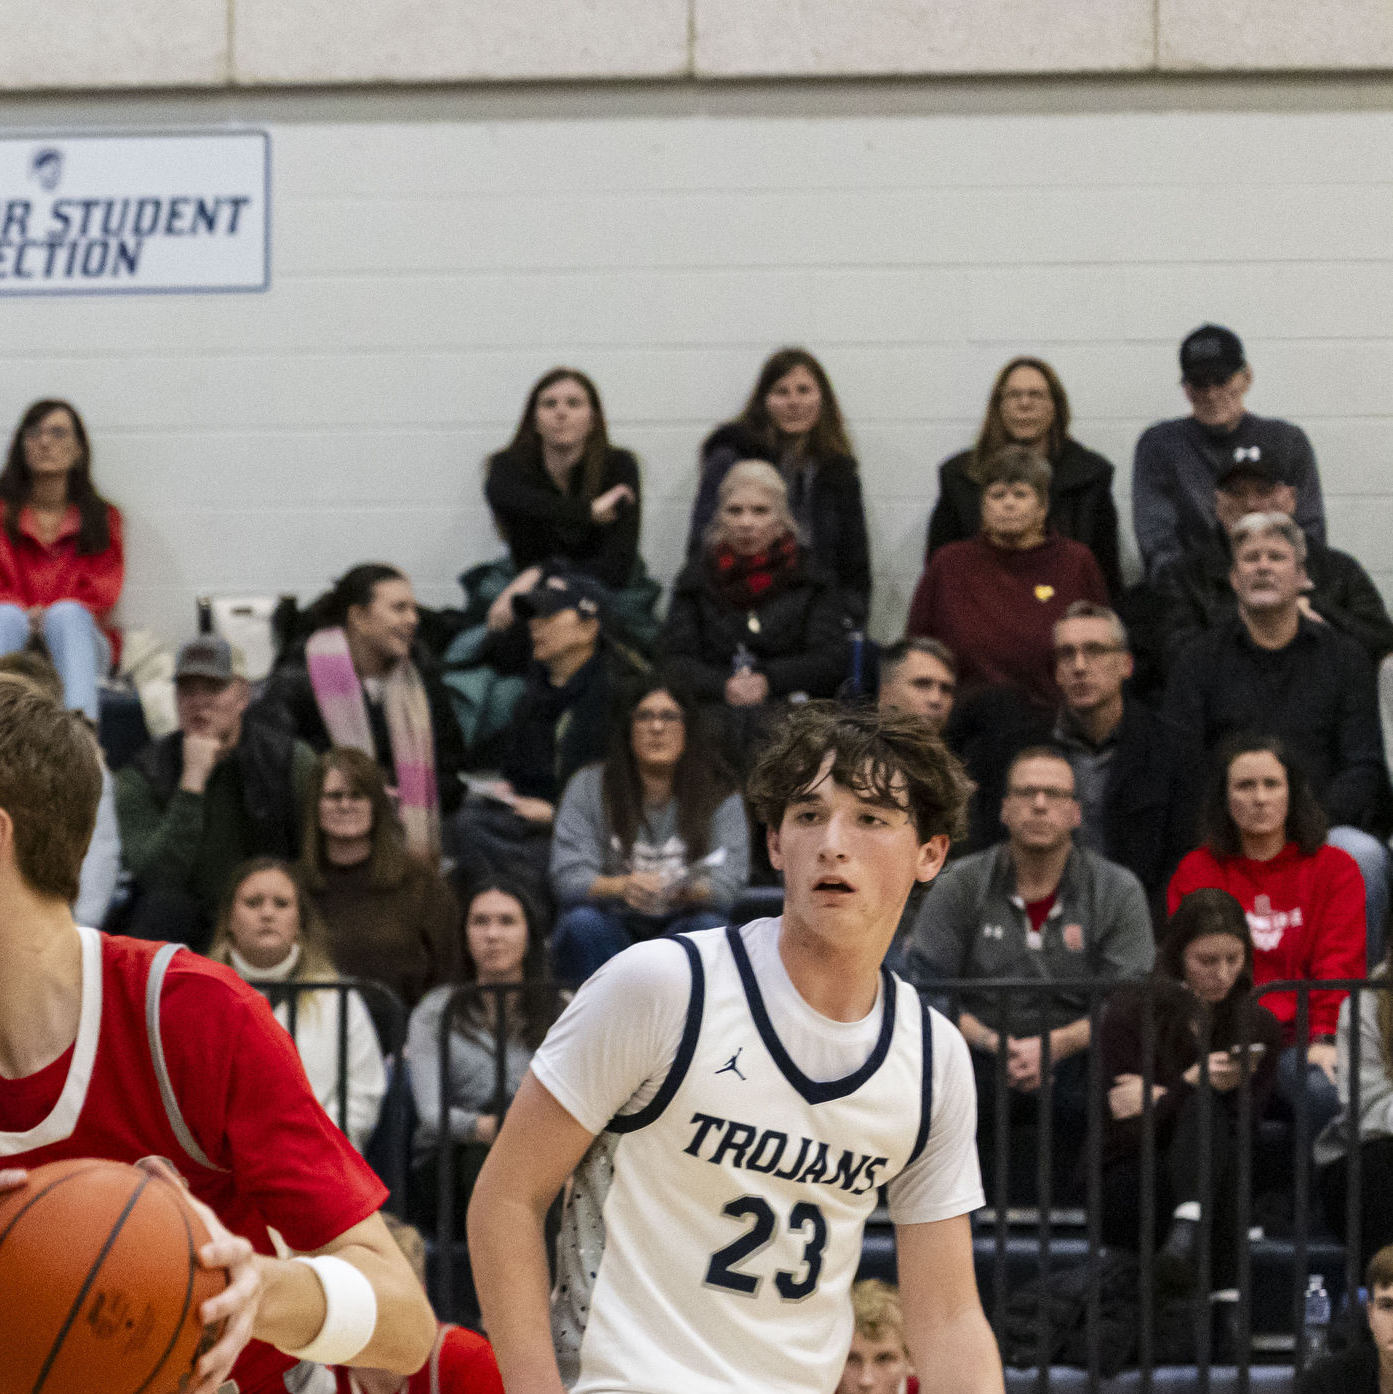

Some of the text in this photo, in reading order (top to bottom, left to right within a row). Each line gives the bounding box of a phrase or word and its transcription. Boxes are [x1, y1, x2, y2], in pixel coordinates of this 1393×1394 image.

[50, 195, 251, 238] STUDENT
[683, 1112, 889, 1196] TROJANS
[703, 1194, 829, 1305] 23
